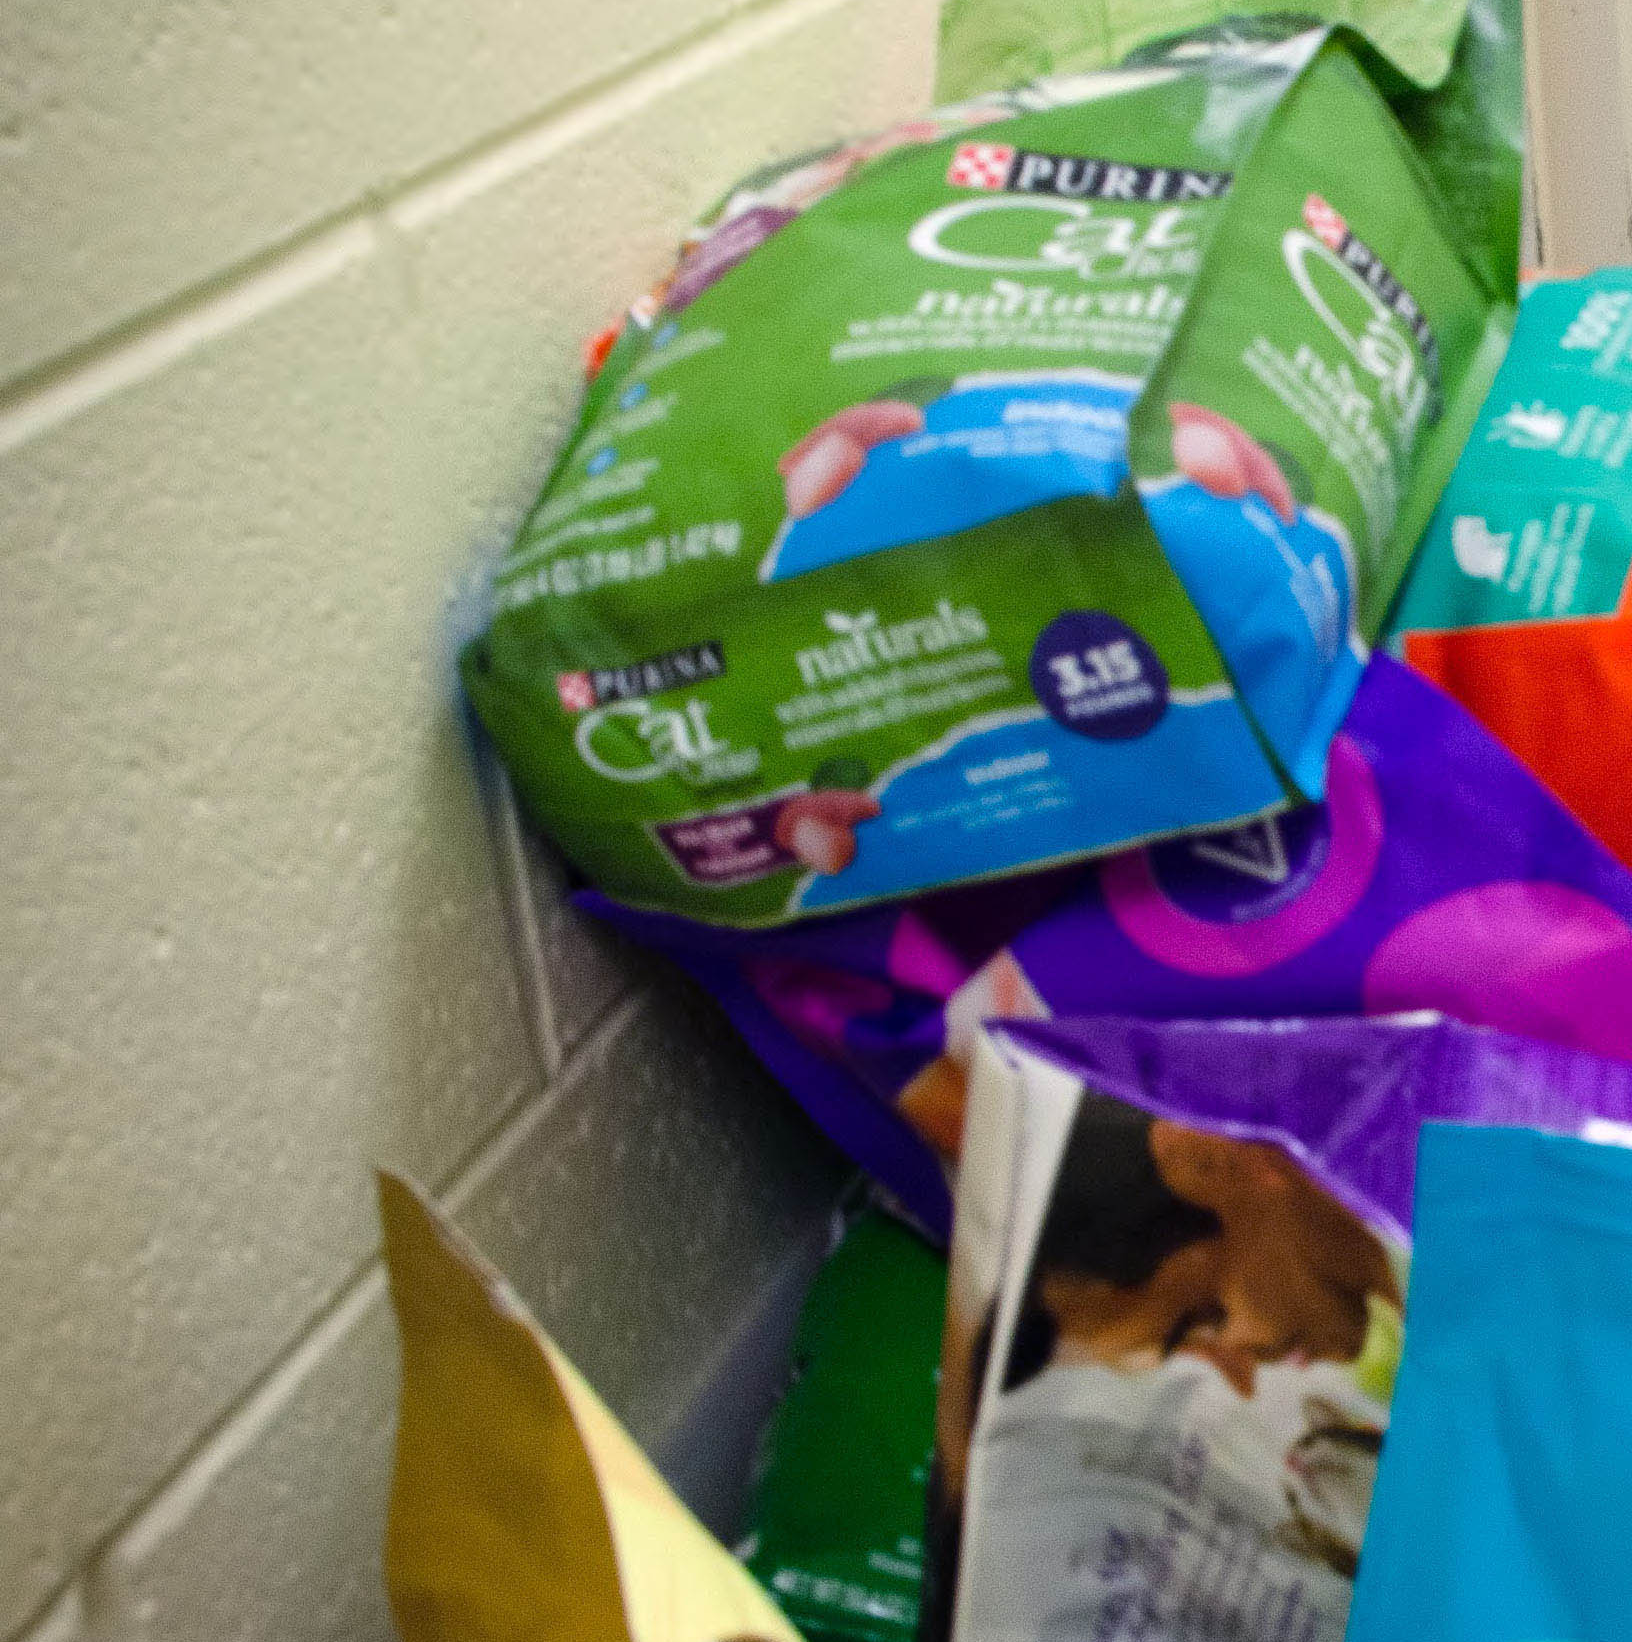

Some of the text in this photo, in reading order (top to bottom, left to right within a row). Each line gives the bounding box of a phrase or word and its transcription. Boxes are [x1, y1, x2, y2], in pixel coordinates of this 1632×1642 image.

[1014, 153, 1232, 202] PURIN
[796, 598, 988, 685] naturals
[1049, 639, 1143, 700] 3.15
[576, 696, 728, 782] Cat
